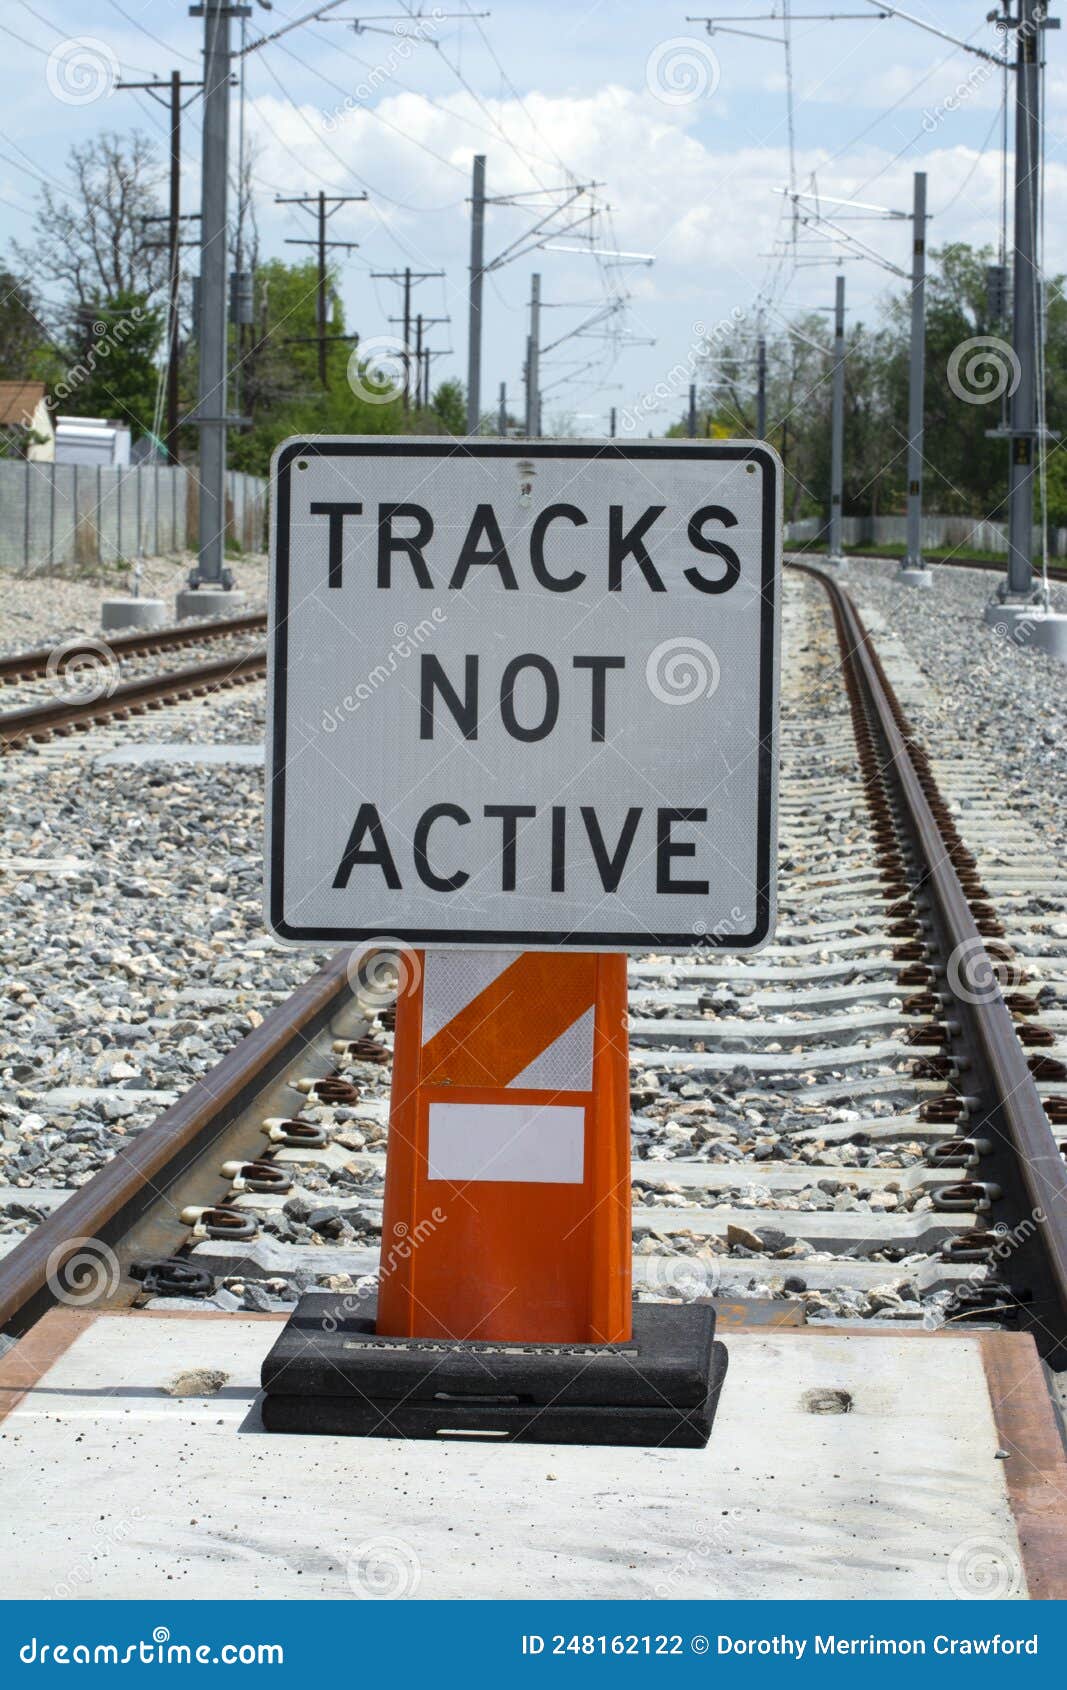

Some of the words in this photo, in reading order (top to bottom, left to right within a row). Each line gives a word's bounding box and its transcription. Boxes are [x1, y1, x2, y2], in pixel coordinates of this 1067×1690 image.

[310, 502, 742, 595] TRACKS
[419, 653, 626, 743] NOT
[331, 802, 710, 896] ACTIVE
